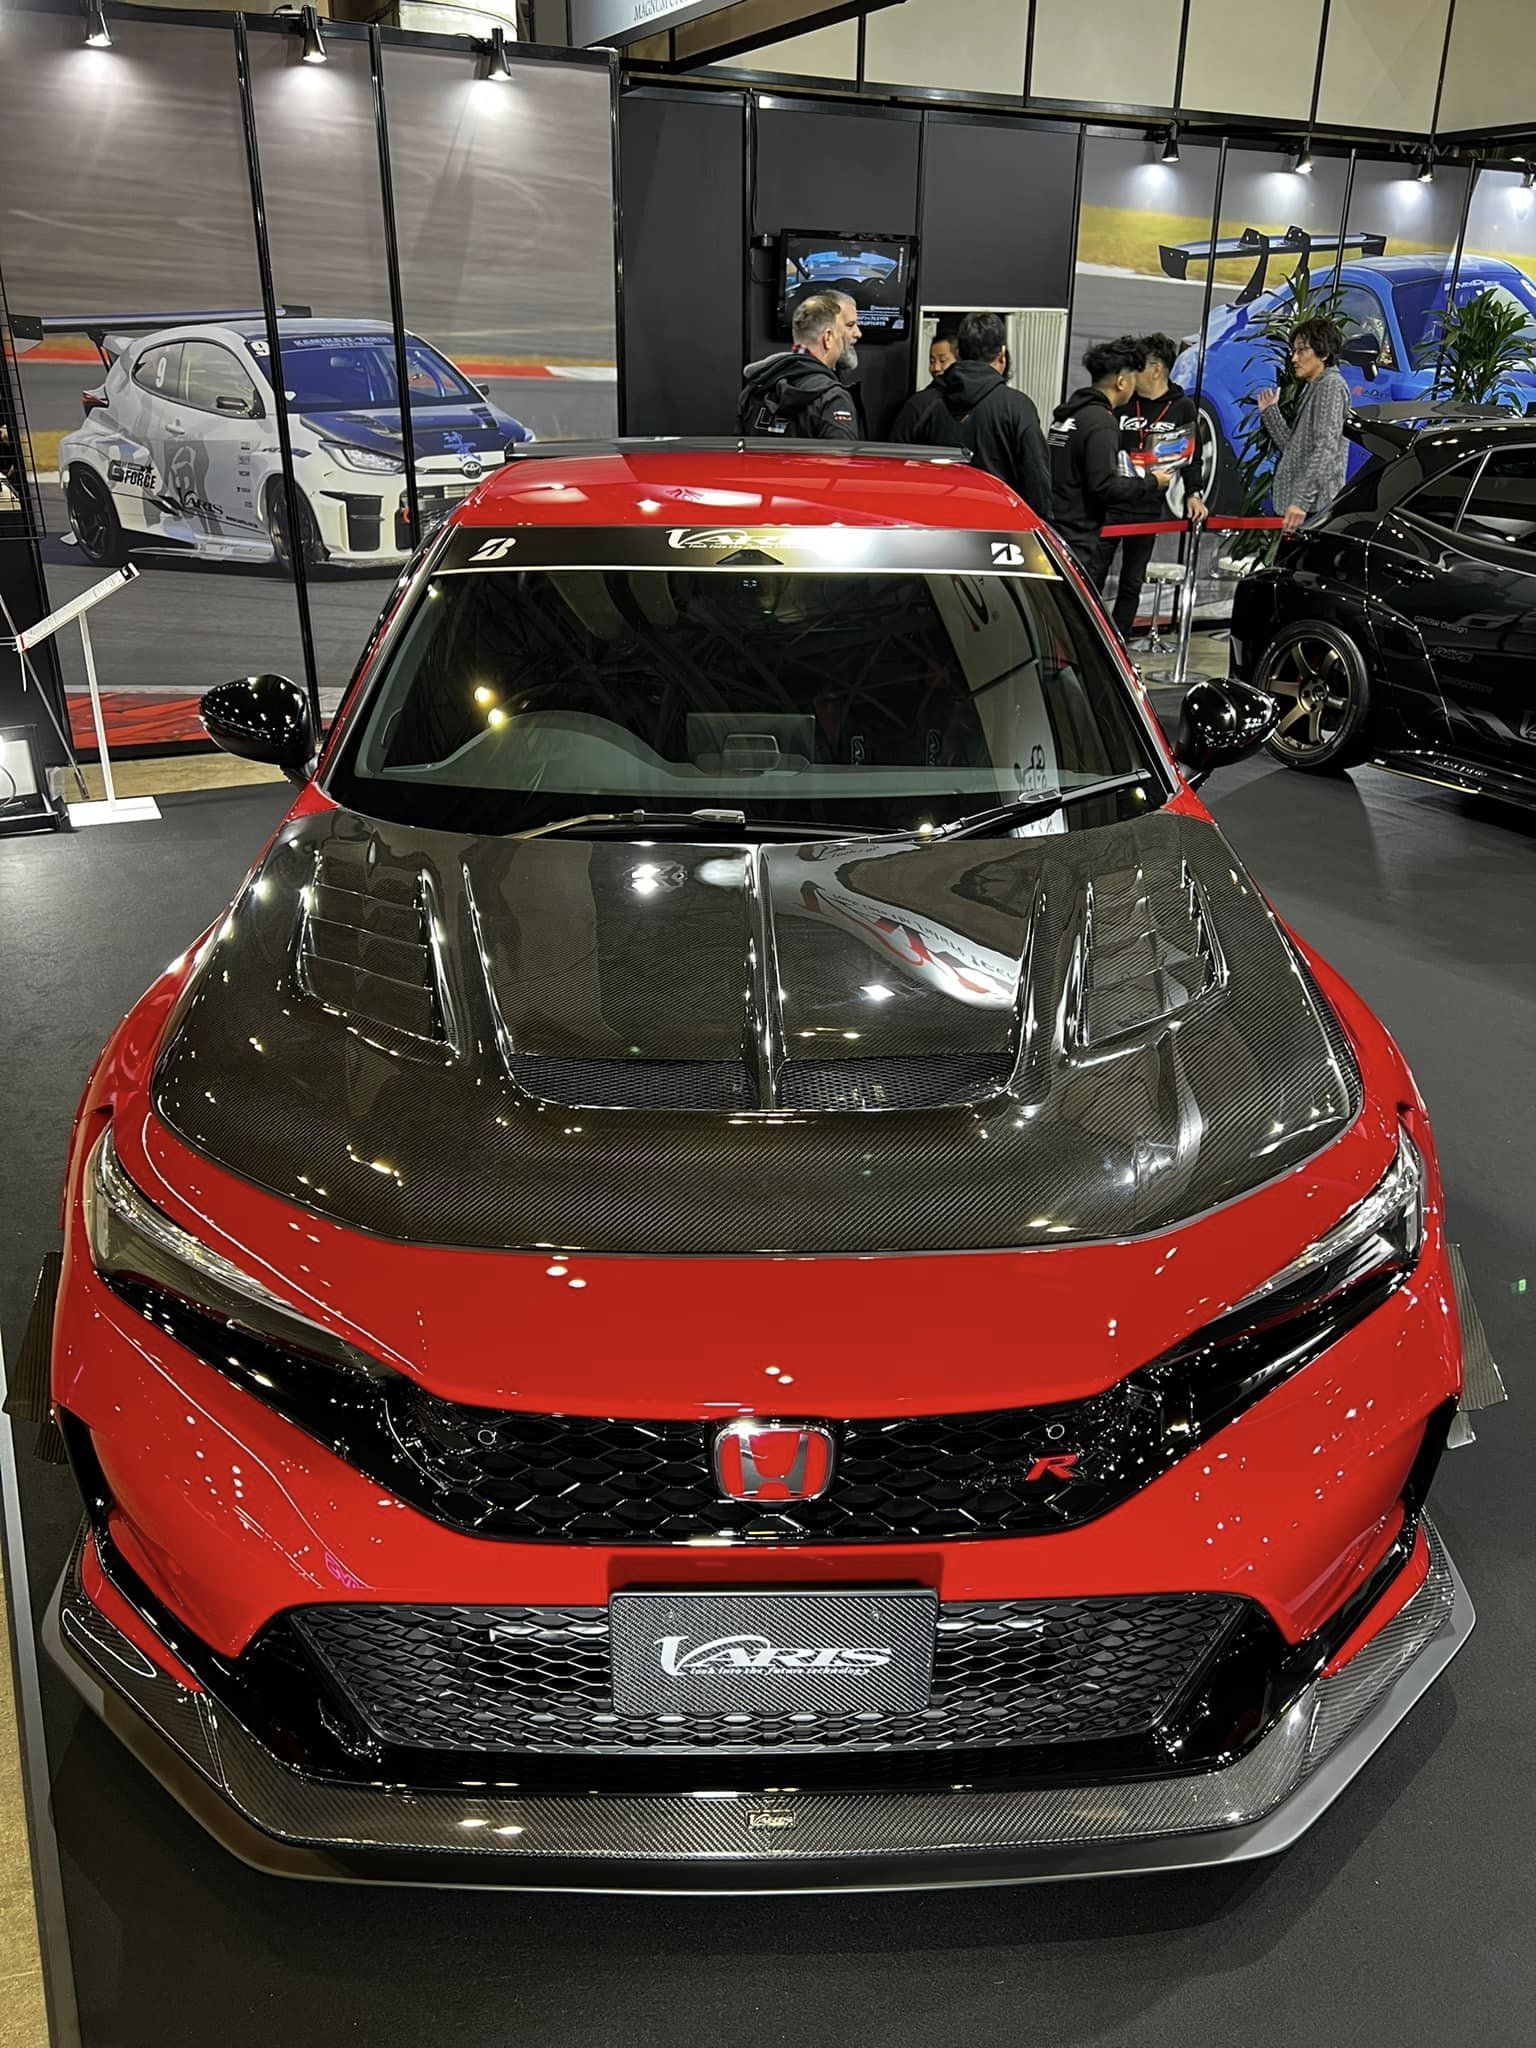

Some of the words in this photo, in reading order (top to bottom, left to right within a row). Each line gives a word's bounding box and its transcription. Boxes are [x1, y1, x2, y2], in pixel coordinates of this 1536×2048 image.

[155, 356, 167, 388] 9
[124, 470, 157, 489] FORCE
[665, 528, 805, 549] VAR
[1024, 1453, 1080, 1482] R
[654, 1634, 893, 1676] VARIS
